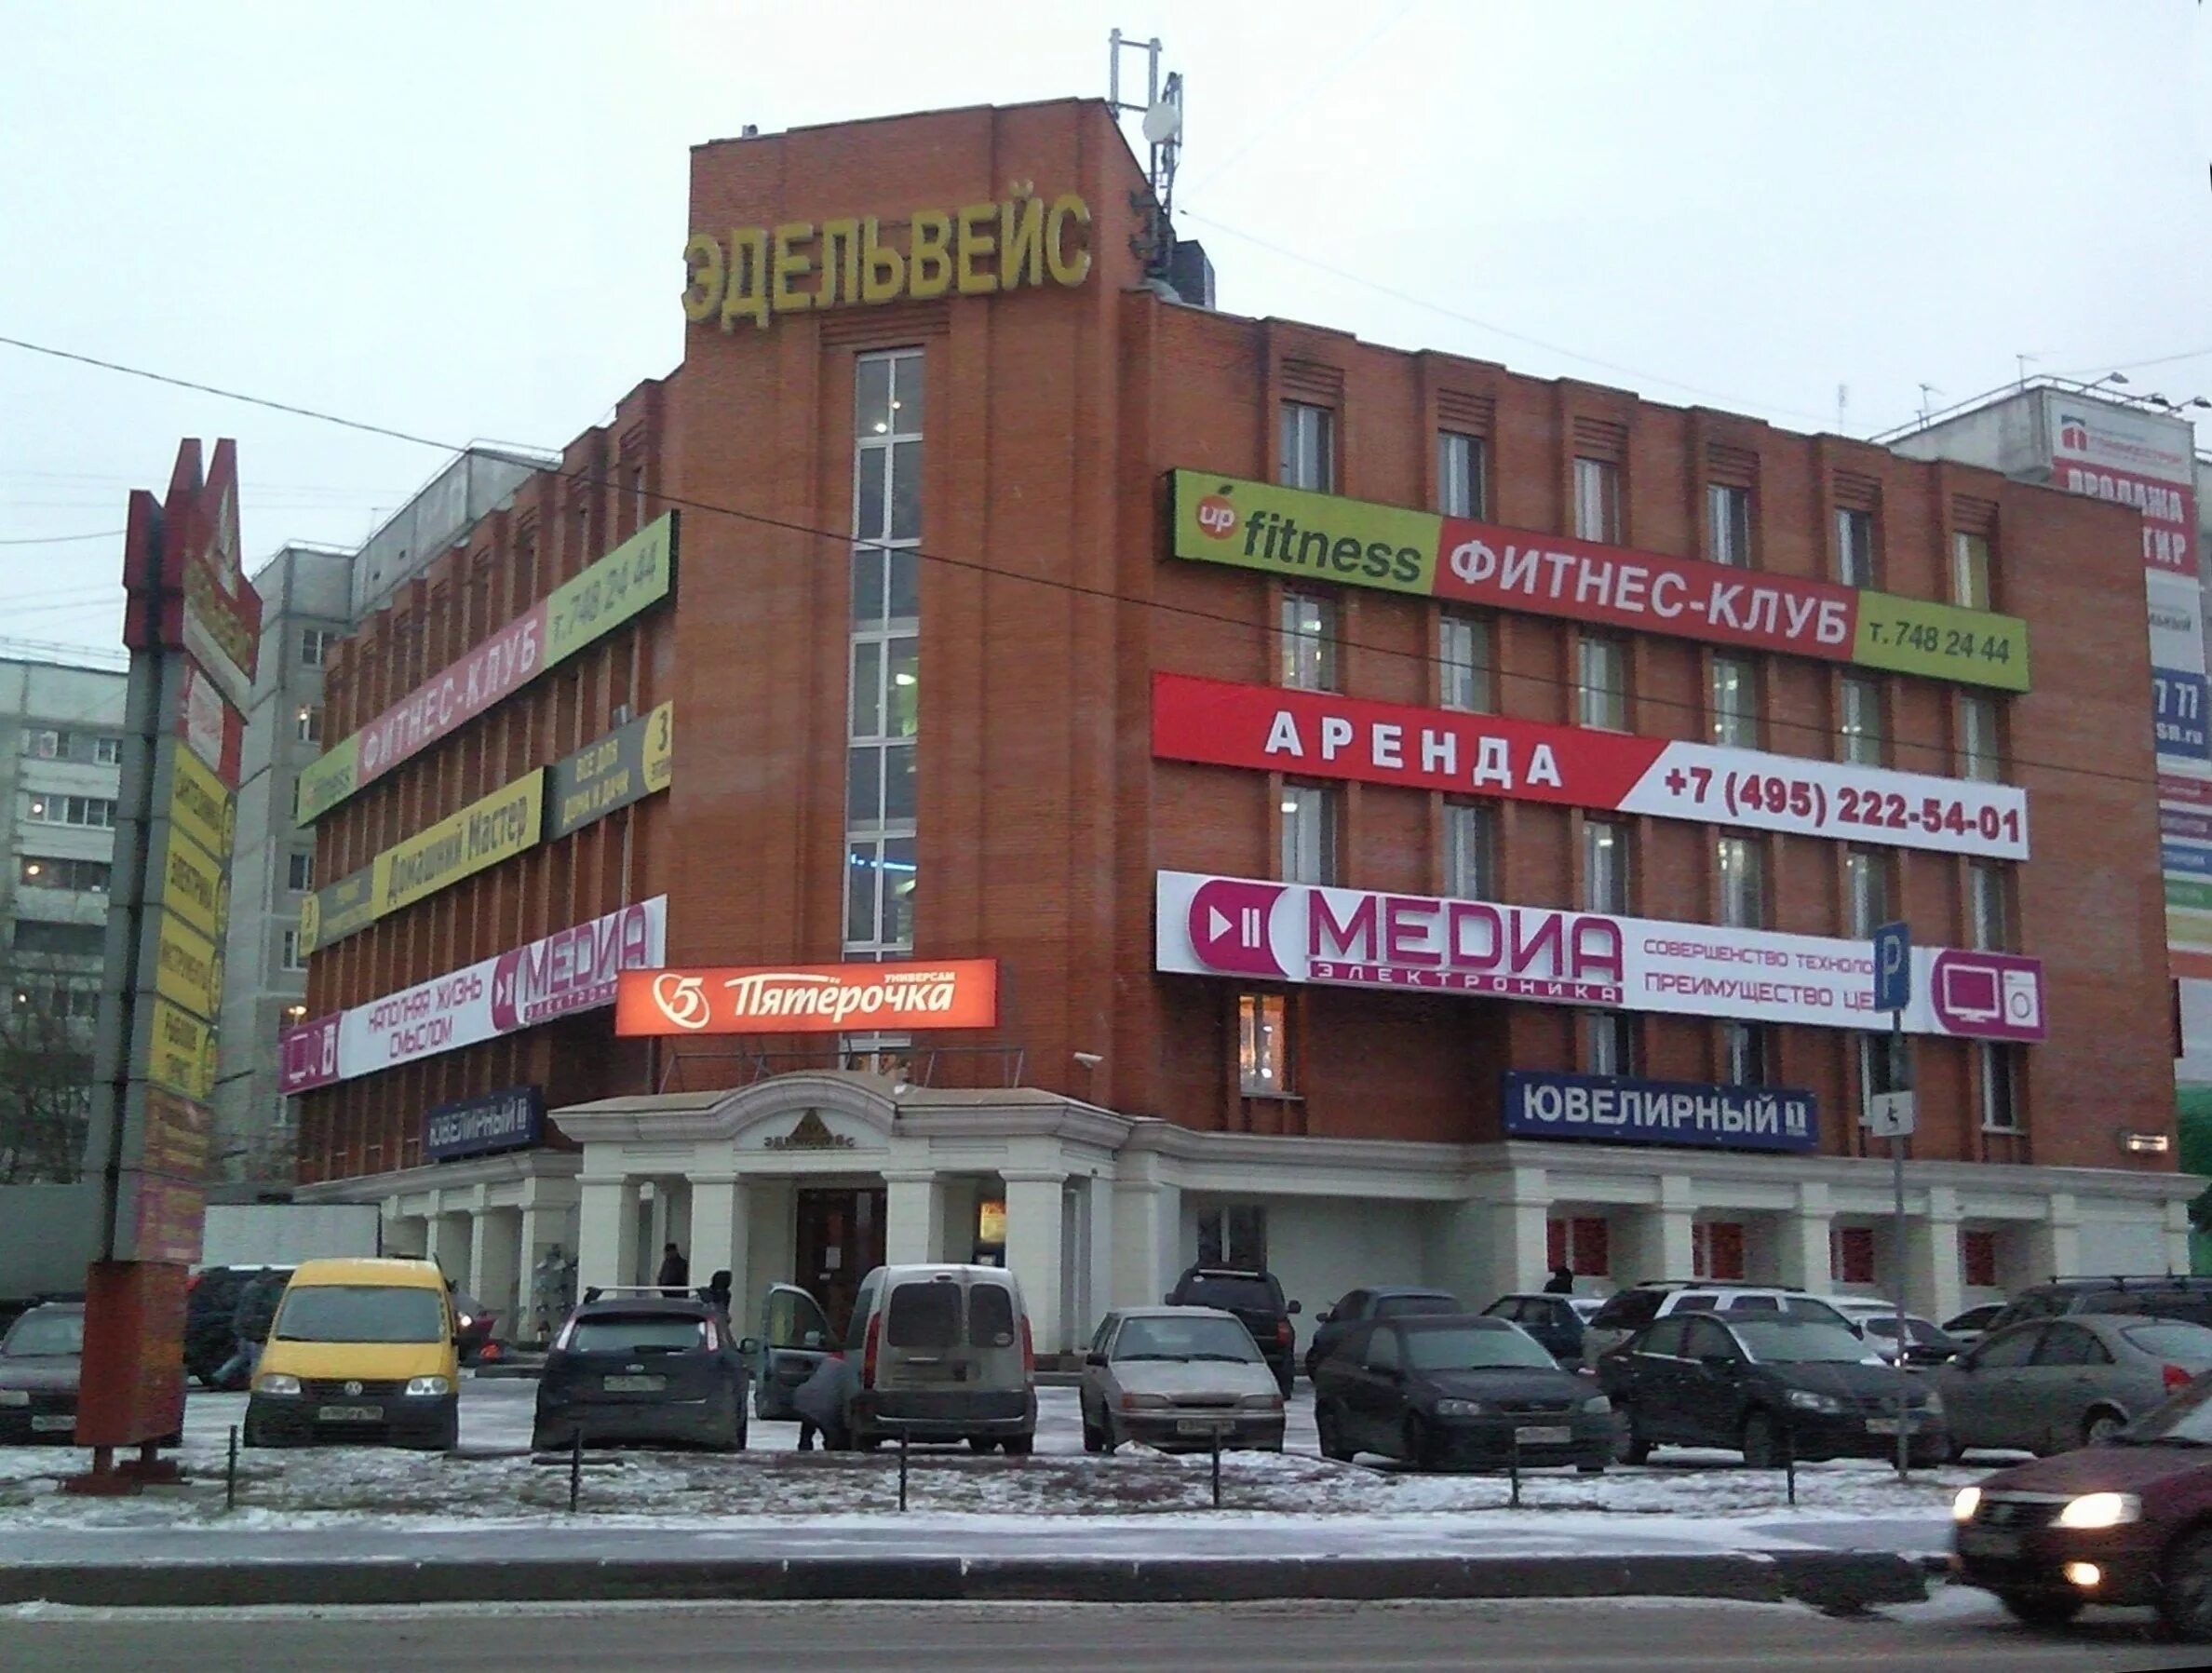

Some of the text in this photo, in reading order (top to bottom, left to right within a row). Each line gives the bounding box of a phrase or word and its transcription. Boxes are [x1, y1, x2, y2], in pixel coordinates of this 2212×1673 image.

[682, 179, 1091, 333] ЭДЕЛЬВЕЙС
[1200, 506, 1235, 533] up
[1244, 510, 1423, 583] fitness
[1450, 539, 1847, 644] ФИТНЕС-КЛУБ
[1945, 630, 1974, 658] 24
[1981, 636, 2010, 665] 44
[1264, 710, 1562, 789] АРЕНДА
[1665, 767, 2019, 843] +7 (495) 222-54-01
[1644, 938, 1875, 975] СОВЕРШЕНСТВО ТЕХНОЛО
[1882, 935, 1901, 999] P
[526, 986, 616, 1019] ЭЛЕКТРОН
[1317, 963, 1616, 1002] ЭЛЕКТРОНИКА
[1645, 973, 1875, 1012] ПРЕИМУЩЕСТВО ЦЕ
[1523, 1085, 1778, 1135] ЮВЕЛИРНЫЙ
